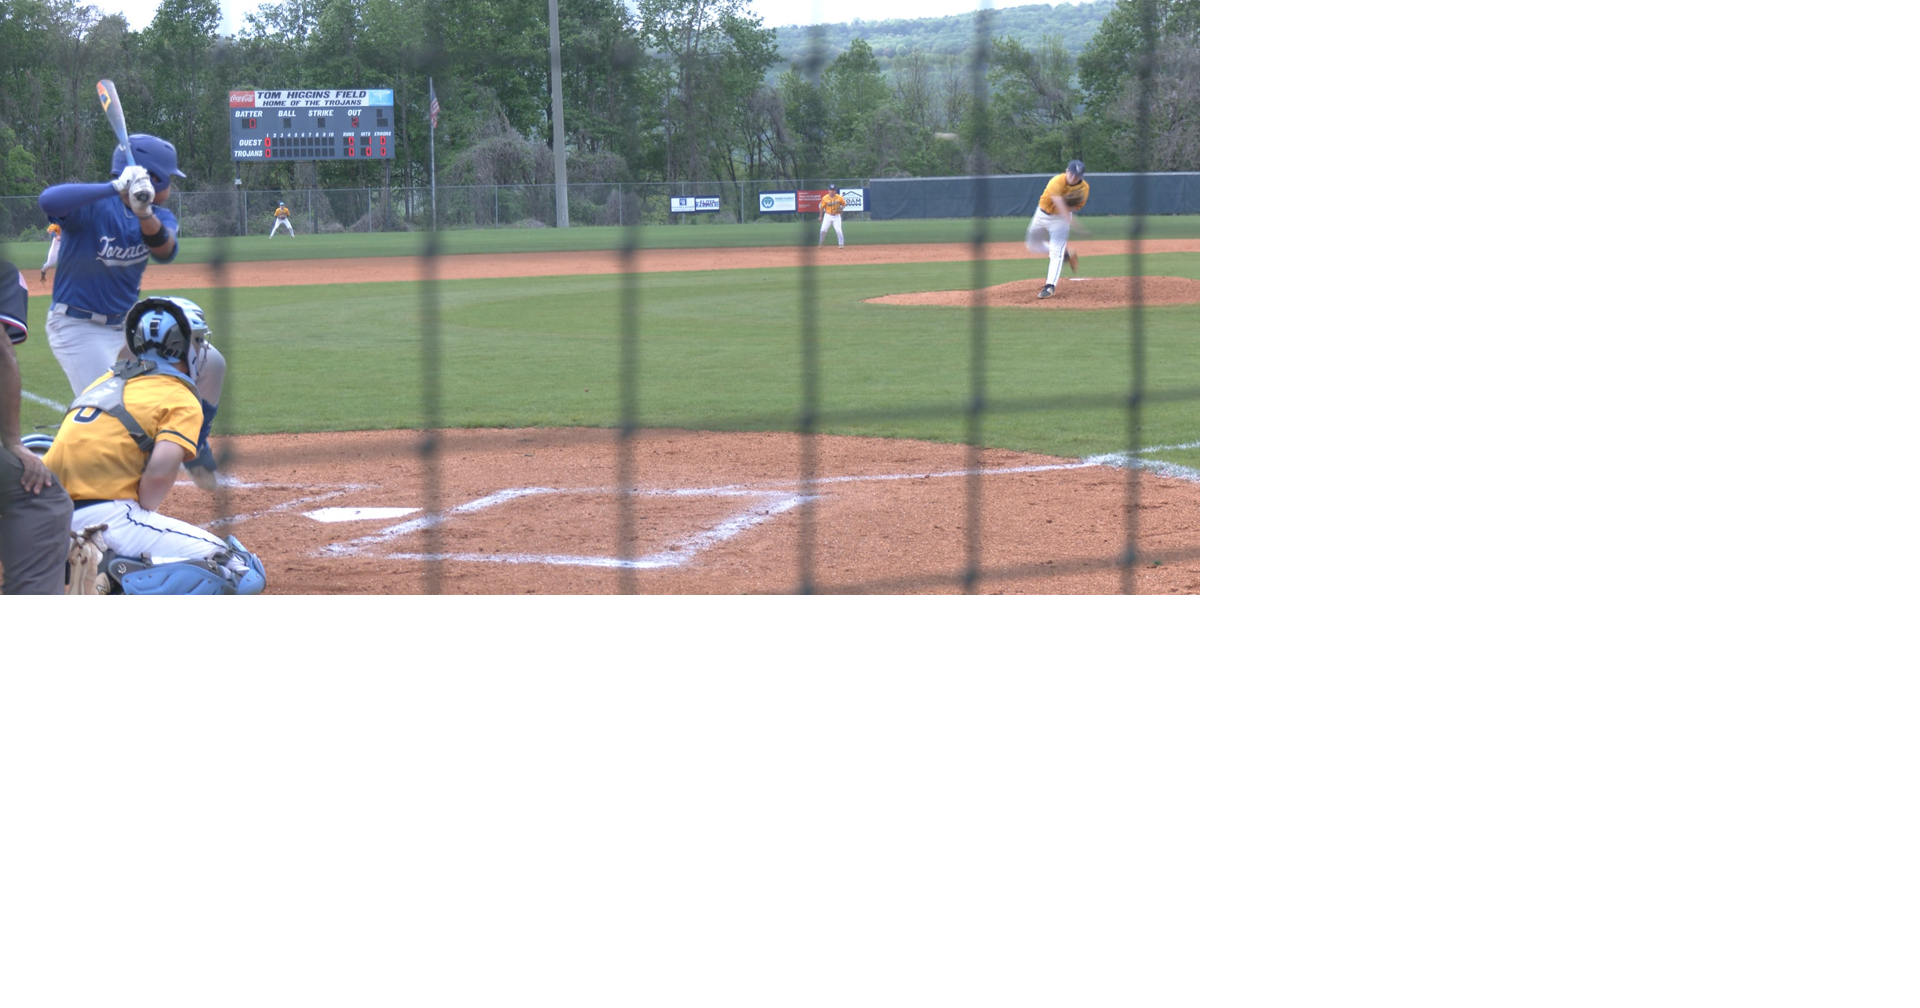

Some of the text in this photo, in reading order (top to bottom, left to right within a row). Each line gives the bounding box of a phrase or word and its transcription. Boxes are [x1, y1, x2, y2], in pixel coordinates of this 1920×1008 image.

[257, 91, 367, 99] TOM HIGGINS FIELD
[234, 110, 263, 118] BATTER
[308, 109, 334, 117] STRIKE
[347, 109, 362, 117] OUT
[249, 116, 359, 129] 0 2
[239, 139, 263, 147] GUEST
[264, 137, 271, 147] 0
[348, 136, 355, 146] 0
[380, 136, 386, 146] 0
[234, 147, 387, 158] TROJANS 0 0 0 0
